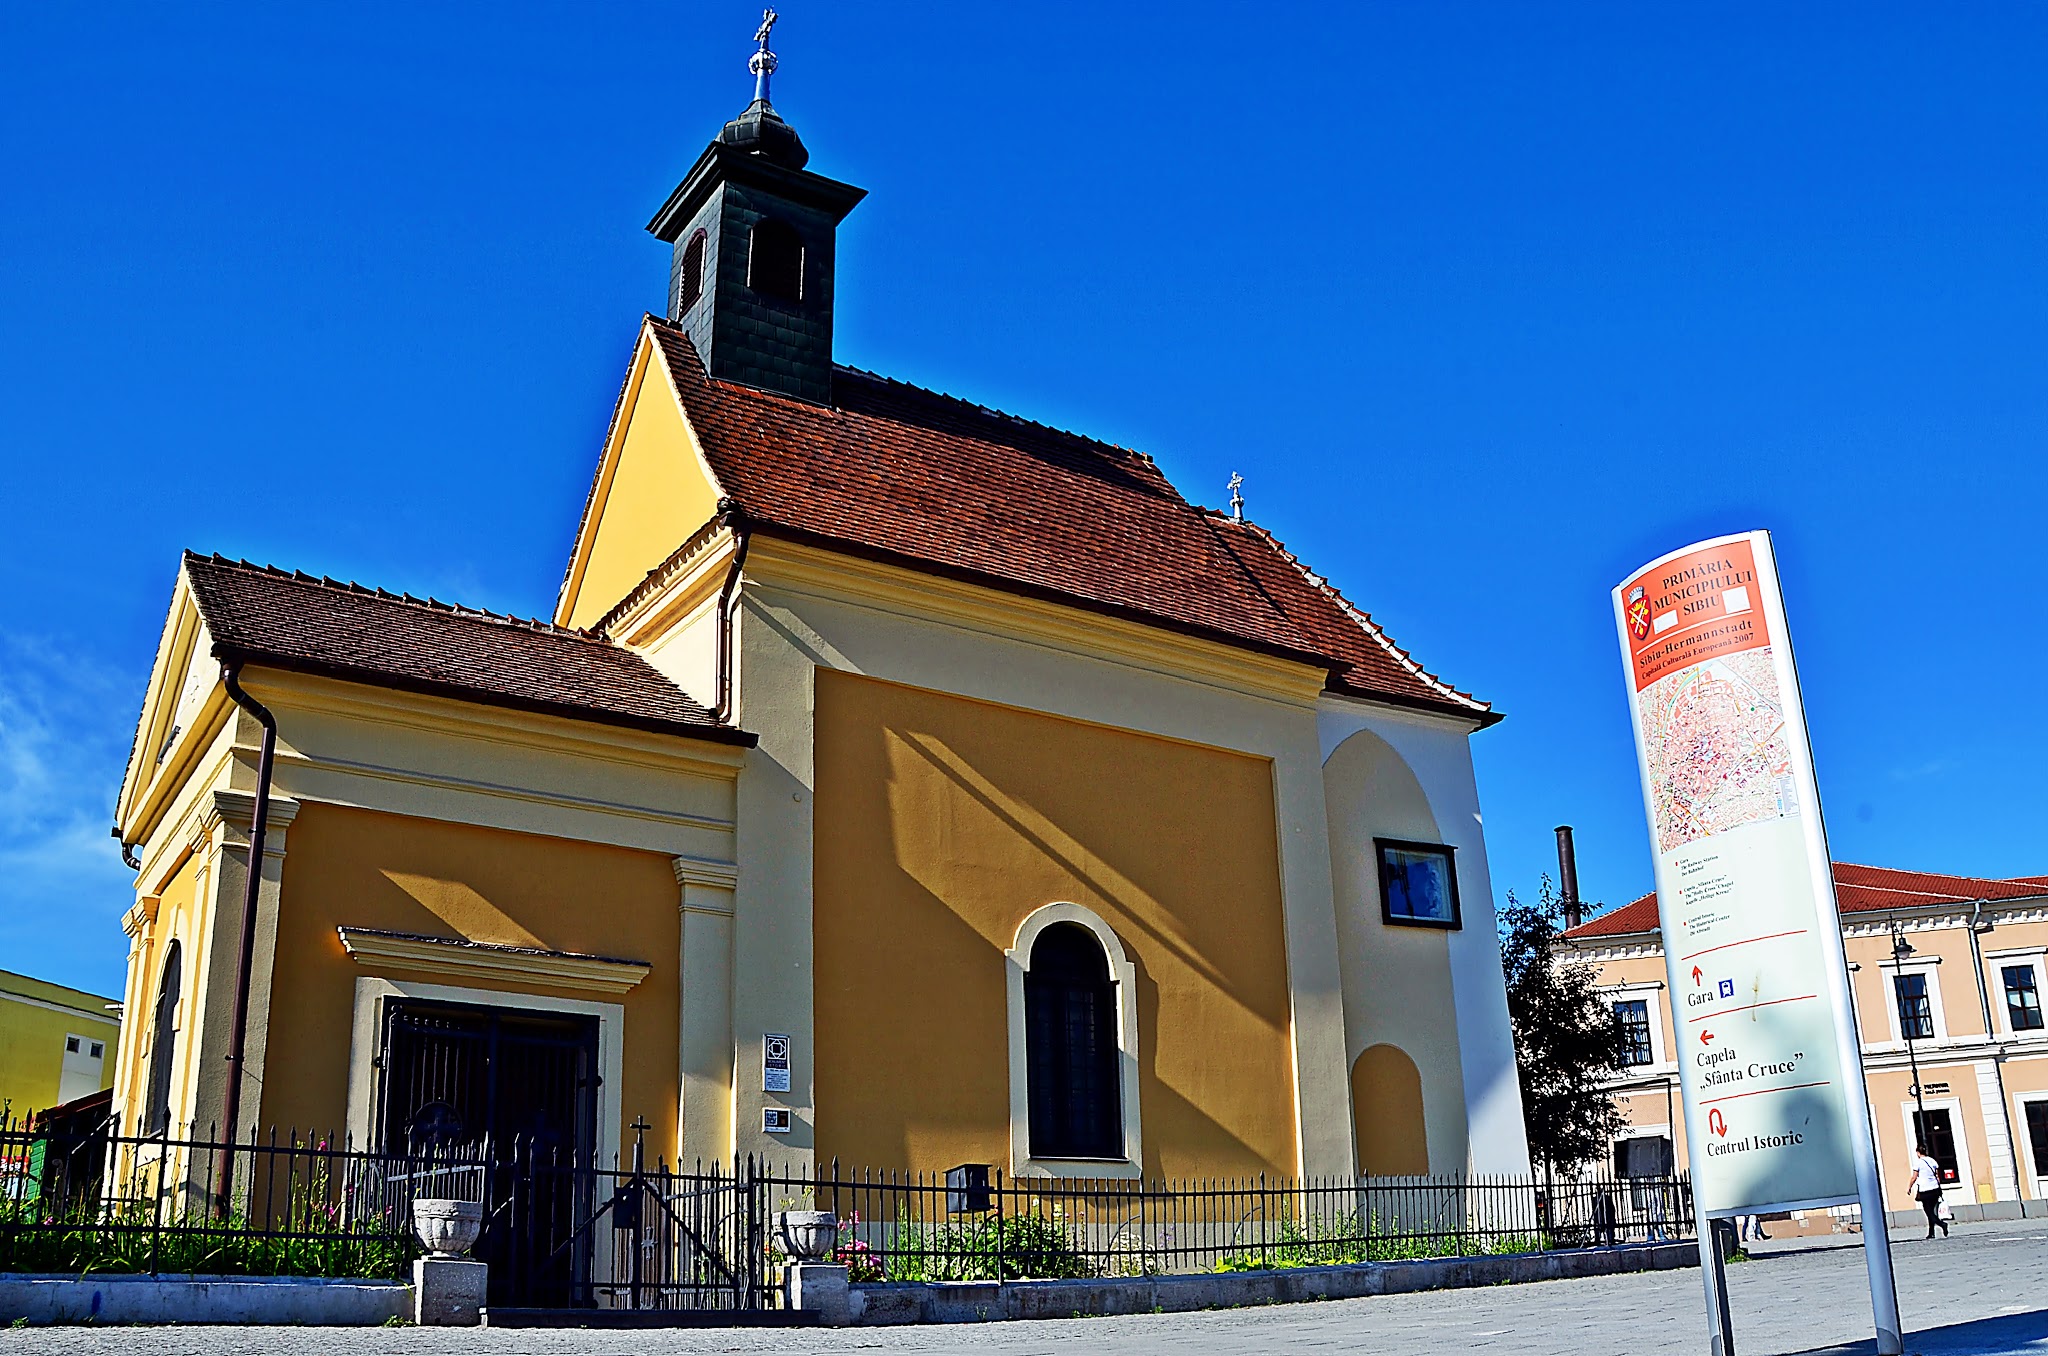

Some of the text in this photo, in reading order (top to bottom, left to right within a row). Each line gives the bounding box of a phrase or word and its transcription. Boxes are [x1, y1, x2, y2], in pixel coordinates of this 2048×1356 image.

[1662, 559, 1733, 589] PRIMĂRIA
[1654, 571, 1752, 611] MUNICIPIULUI
[1683, 595, 1720, 616] SIBIU
[1640, 620, 1752, 668] Sibiu-Hermannstadt
[1662, 650, 1692, 668] Culturală
[1693, 637, 1732, 655] Europeană
[1734, 632, 1754, 644] 2007
[1687, 990, 1714, 1008] Gara
[1696, 1047, 1737, 1067] Capela
[1707, 1130, 1804, 1157] Centrul Istoric
